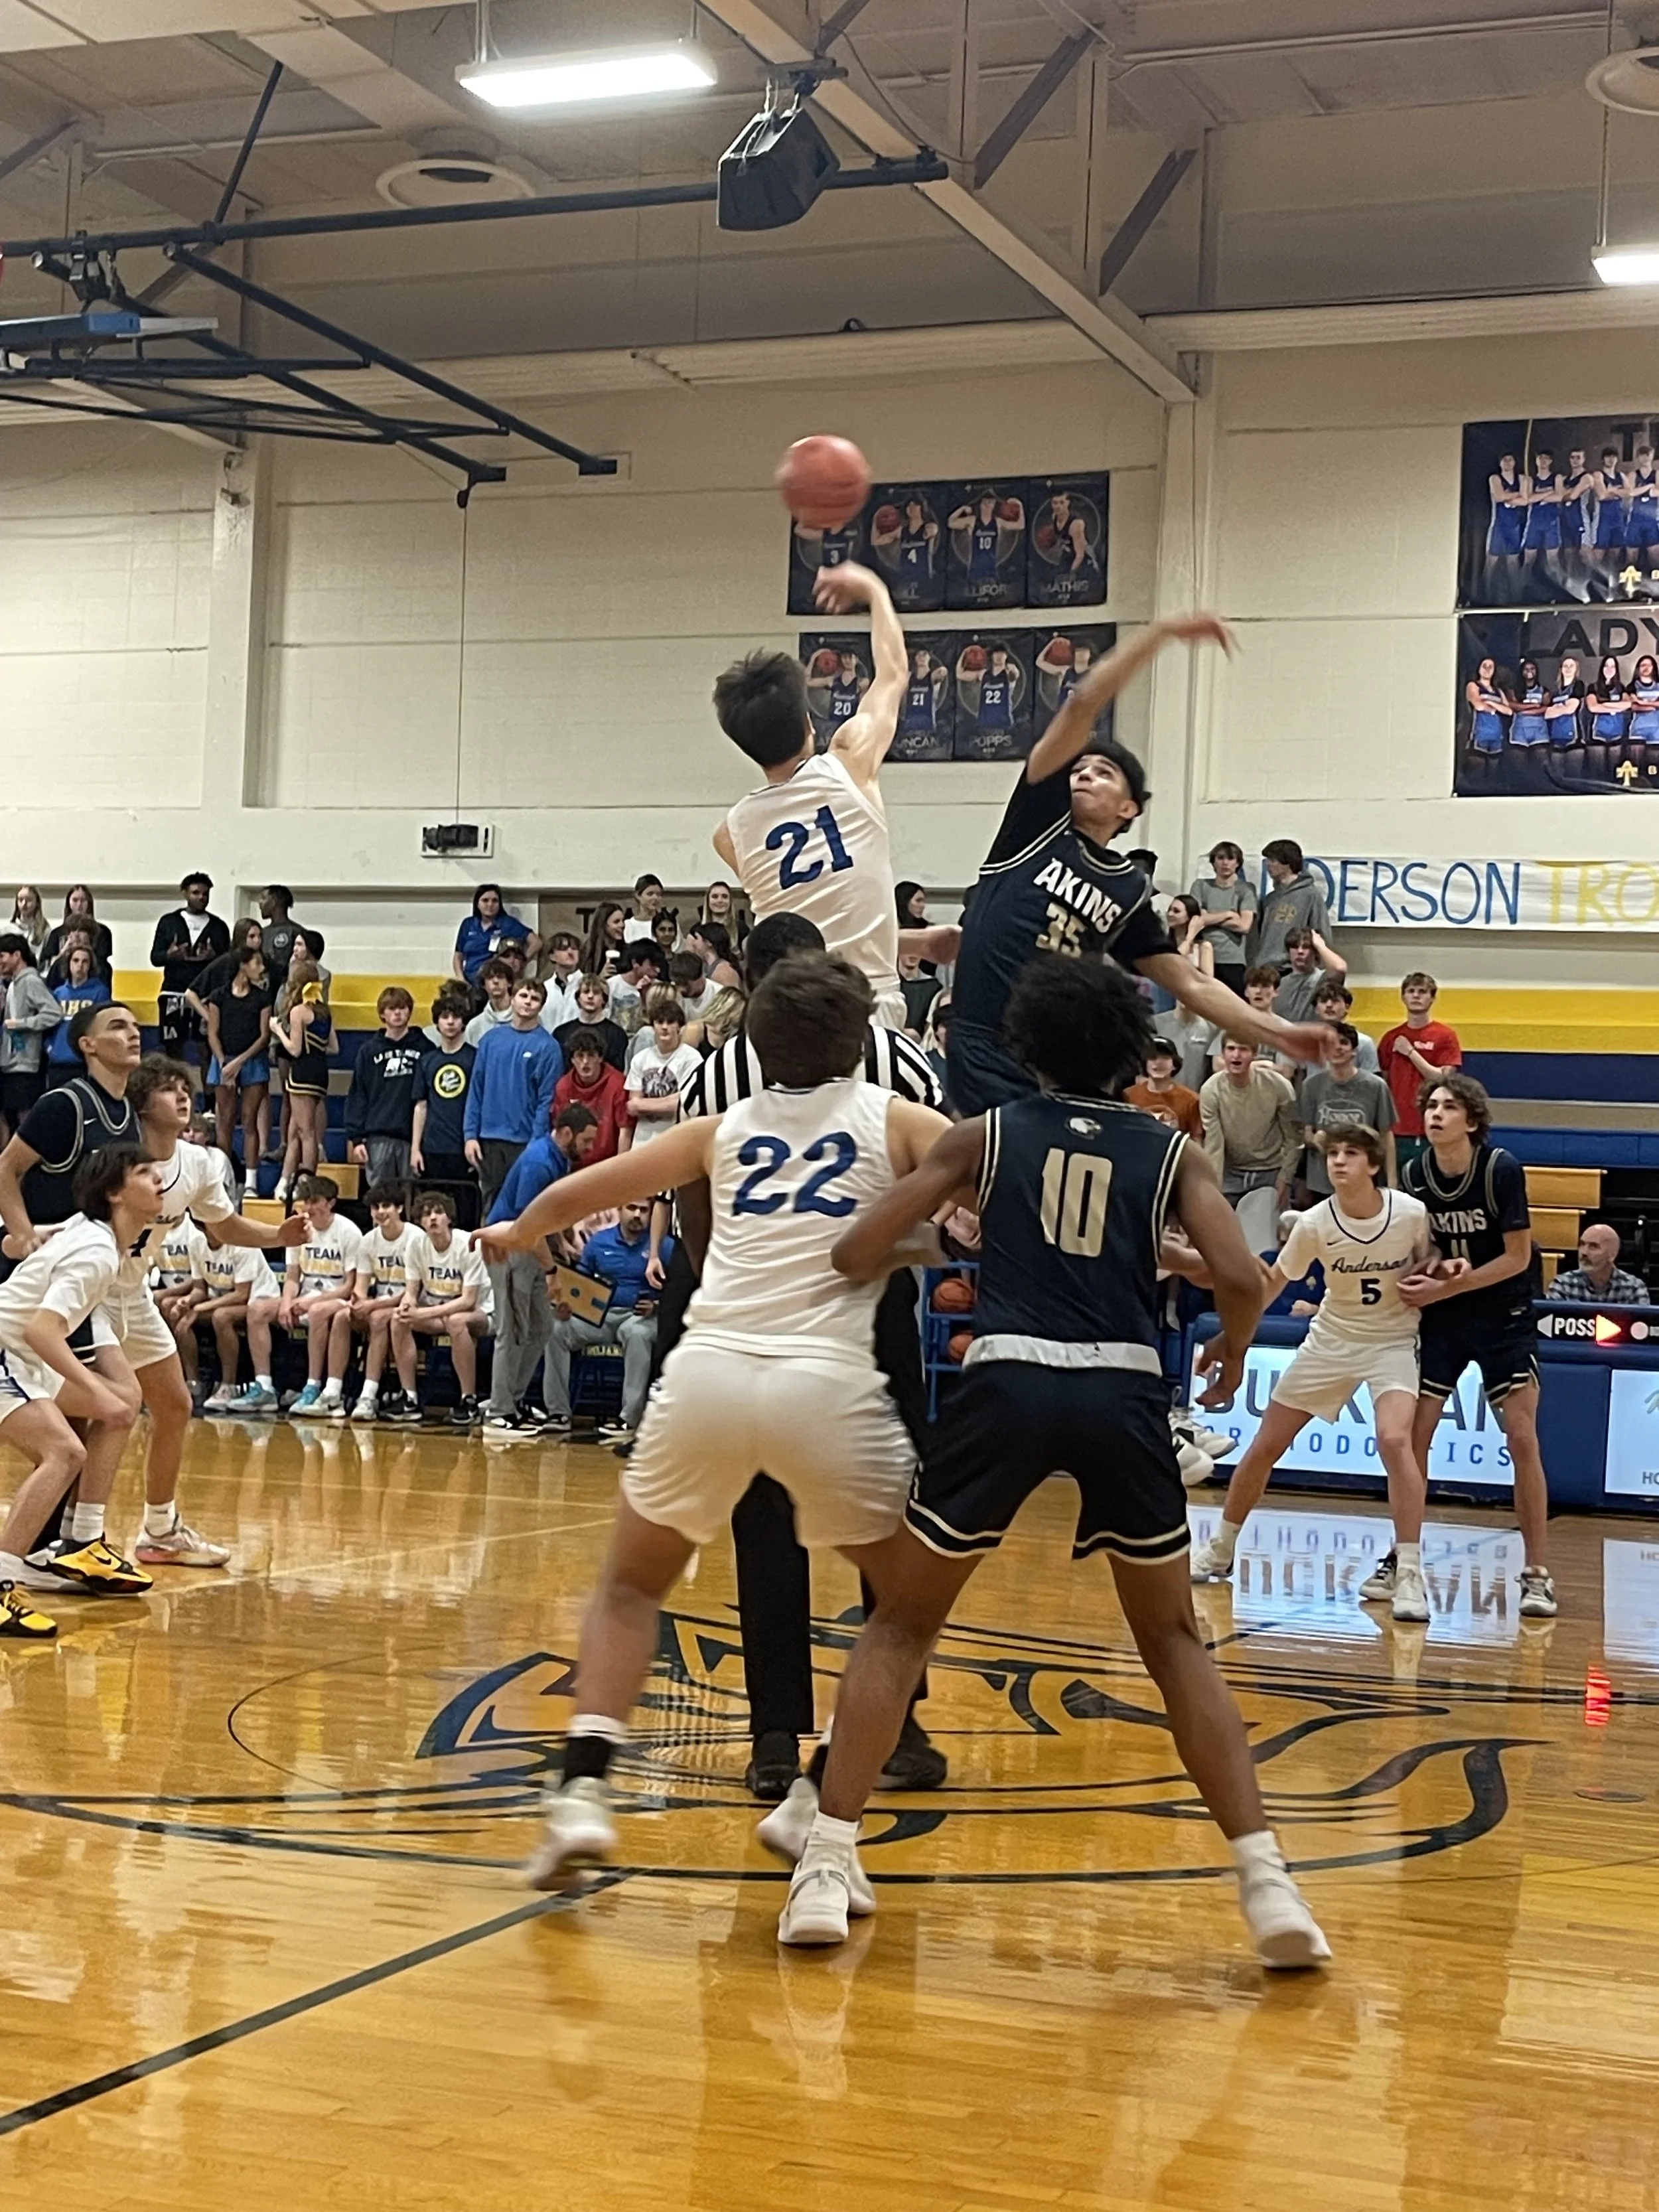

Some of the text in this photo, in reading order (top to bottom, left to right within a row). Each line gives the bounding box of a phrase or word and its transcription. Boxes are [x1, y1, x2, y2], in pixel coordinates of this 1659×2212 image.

[979, 537, 991, 550] 10
[830, 550, 839, 563] 3
[908, 549, 917, 563] 4
[912, 693, 924, 706] 21
[985, 690, 1001, 704] 22
[833, 701, 851, 716] 20
[765, 804, 854, 890] 21
[1033, 857, 1122, 933] AKINS
[1035, 902, 1086, 958] 35
[731, 1131, 858, 1218] 22
[1040, 1147, 1113, 1257] 10
[305, 1247, 342, 1261] TEAM
[428, 1266, 463, 1280] TEAM
[1360, 1278, 1382, 1305] 5
